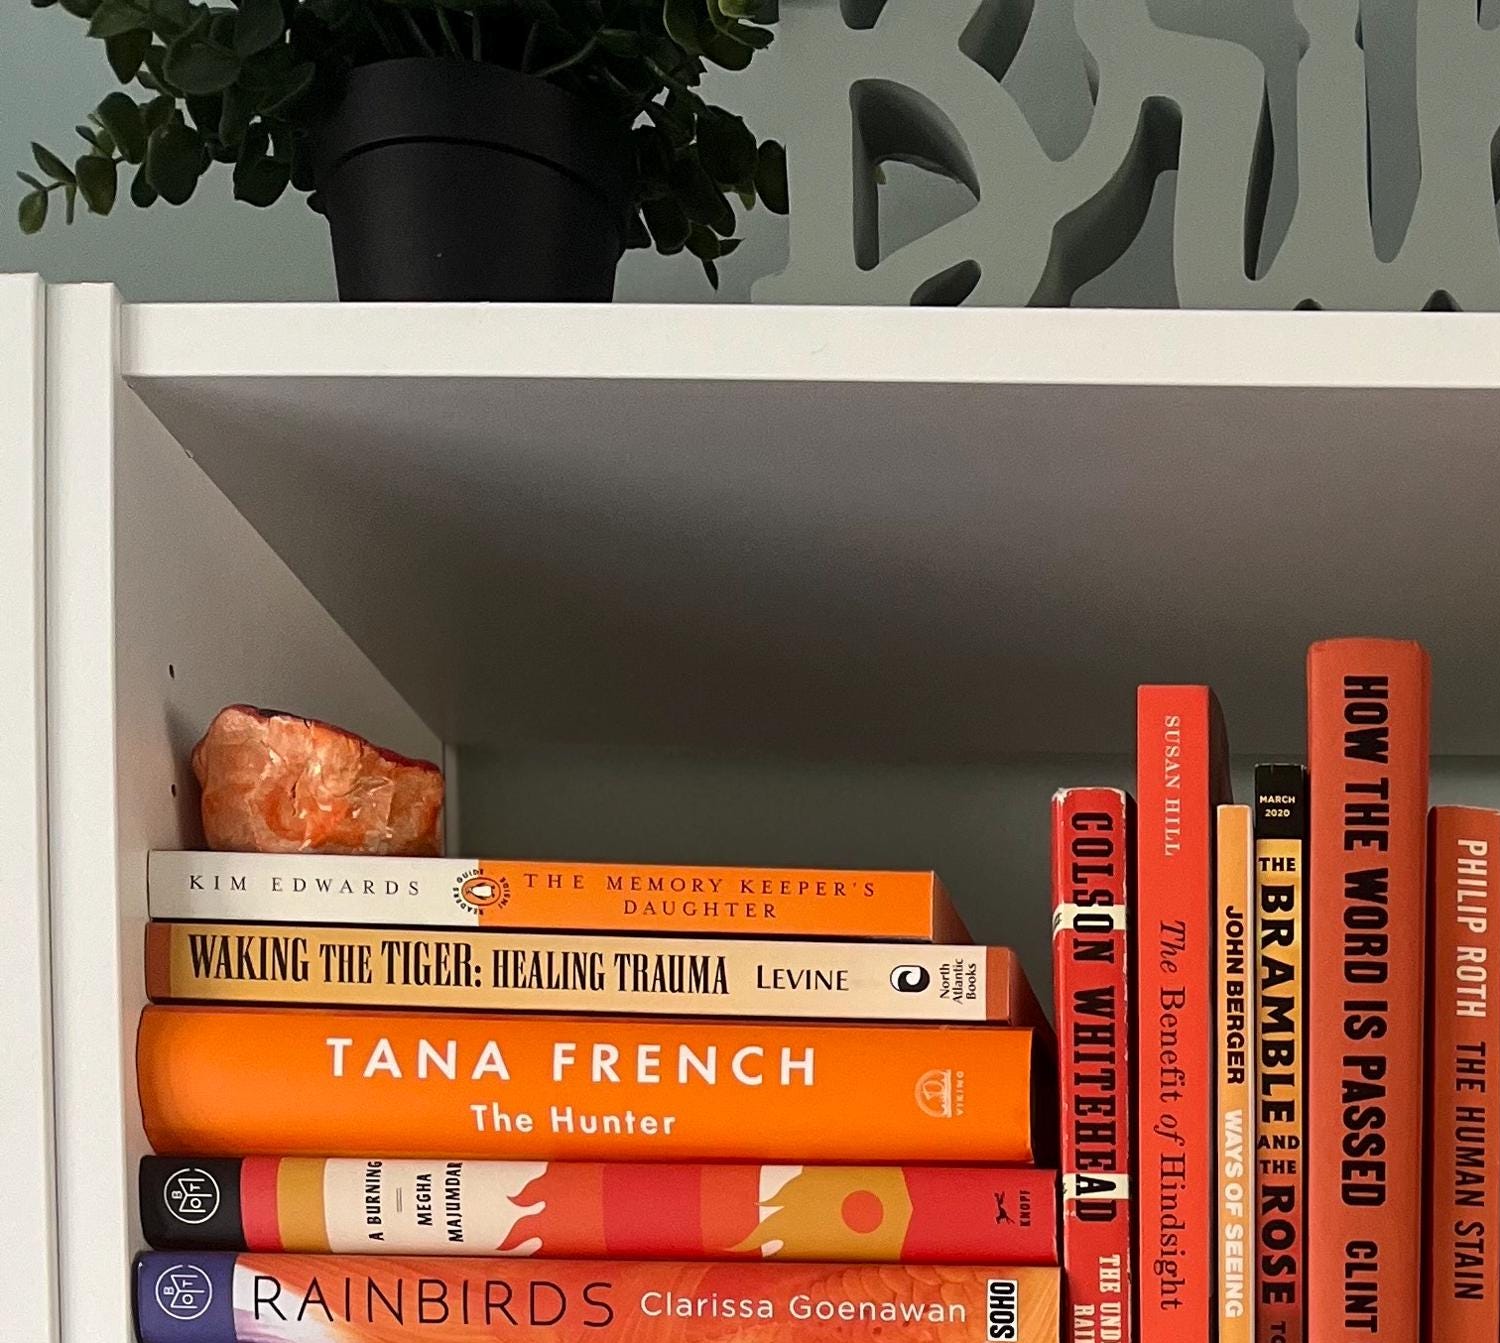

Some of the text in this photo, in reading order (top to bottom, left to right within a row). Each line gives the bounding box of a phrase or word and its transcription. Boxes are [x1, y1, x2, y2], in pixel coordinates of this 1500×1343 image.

[1259, 795, 1296, 804] MARCH
[1265, 808, 1291, 817] 2020
[189, 874, 421, 896] KIM EDWARDS
[1258, 857, 1296, 872] THE
[607, 875, 875, 898] MEMORY KEEPER'S
[623, 899, 777, 919] DAUGHTER
[1341, 675, 1390, 1207] HOW THE WORD IS PASSED
[188, 934, 730, 995] WAKING THE TIGER: HEALING TRAUMA
[756, 964, 850, 992] LEVINE
[938, 962, 951, 1000] North
[952, 957, 964, 1005] Atlantic
[966, 962, 977, 1000] Books
[1072, 812, 1117, 1222] COLSON WHITEHEAD
[1260, 884, 1296, 1124] BRAMBLE
[326, 1037, 815, 1087] TANA FRENCH
[1454, 839, 1488, 1300] PHILIP ROTH THE HUMAN STAIN
[470, 1104, 676, 1135] The Hunter
[1153, 986, 1186, 1311] Benefit Hindsight
[1258, 1135, 1301, 1174] AND THE
[417, 1173, 433, 1226] MEGHA
[1261, 1185, 1297, 1304] ROSE
[253, 1275, 615, 1328] RAINBIRDS
[640, 1291, 966, 1323] Clarissa Goenawan
[1344, 1240, 1378, 1334] CLINT
